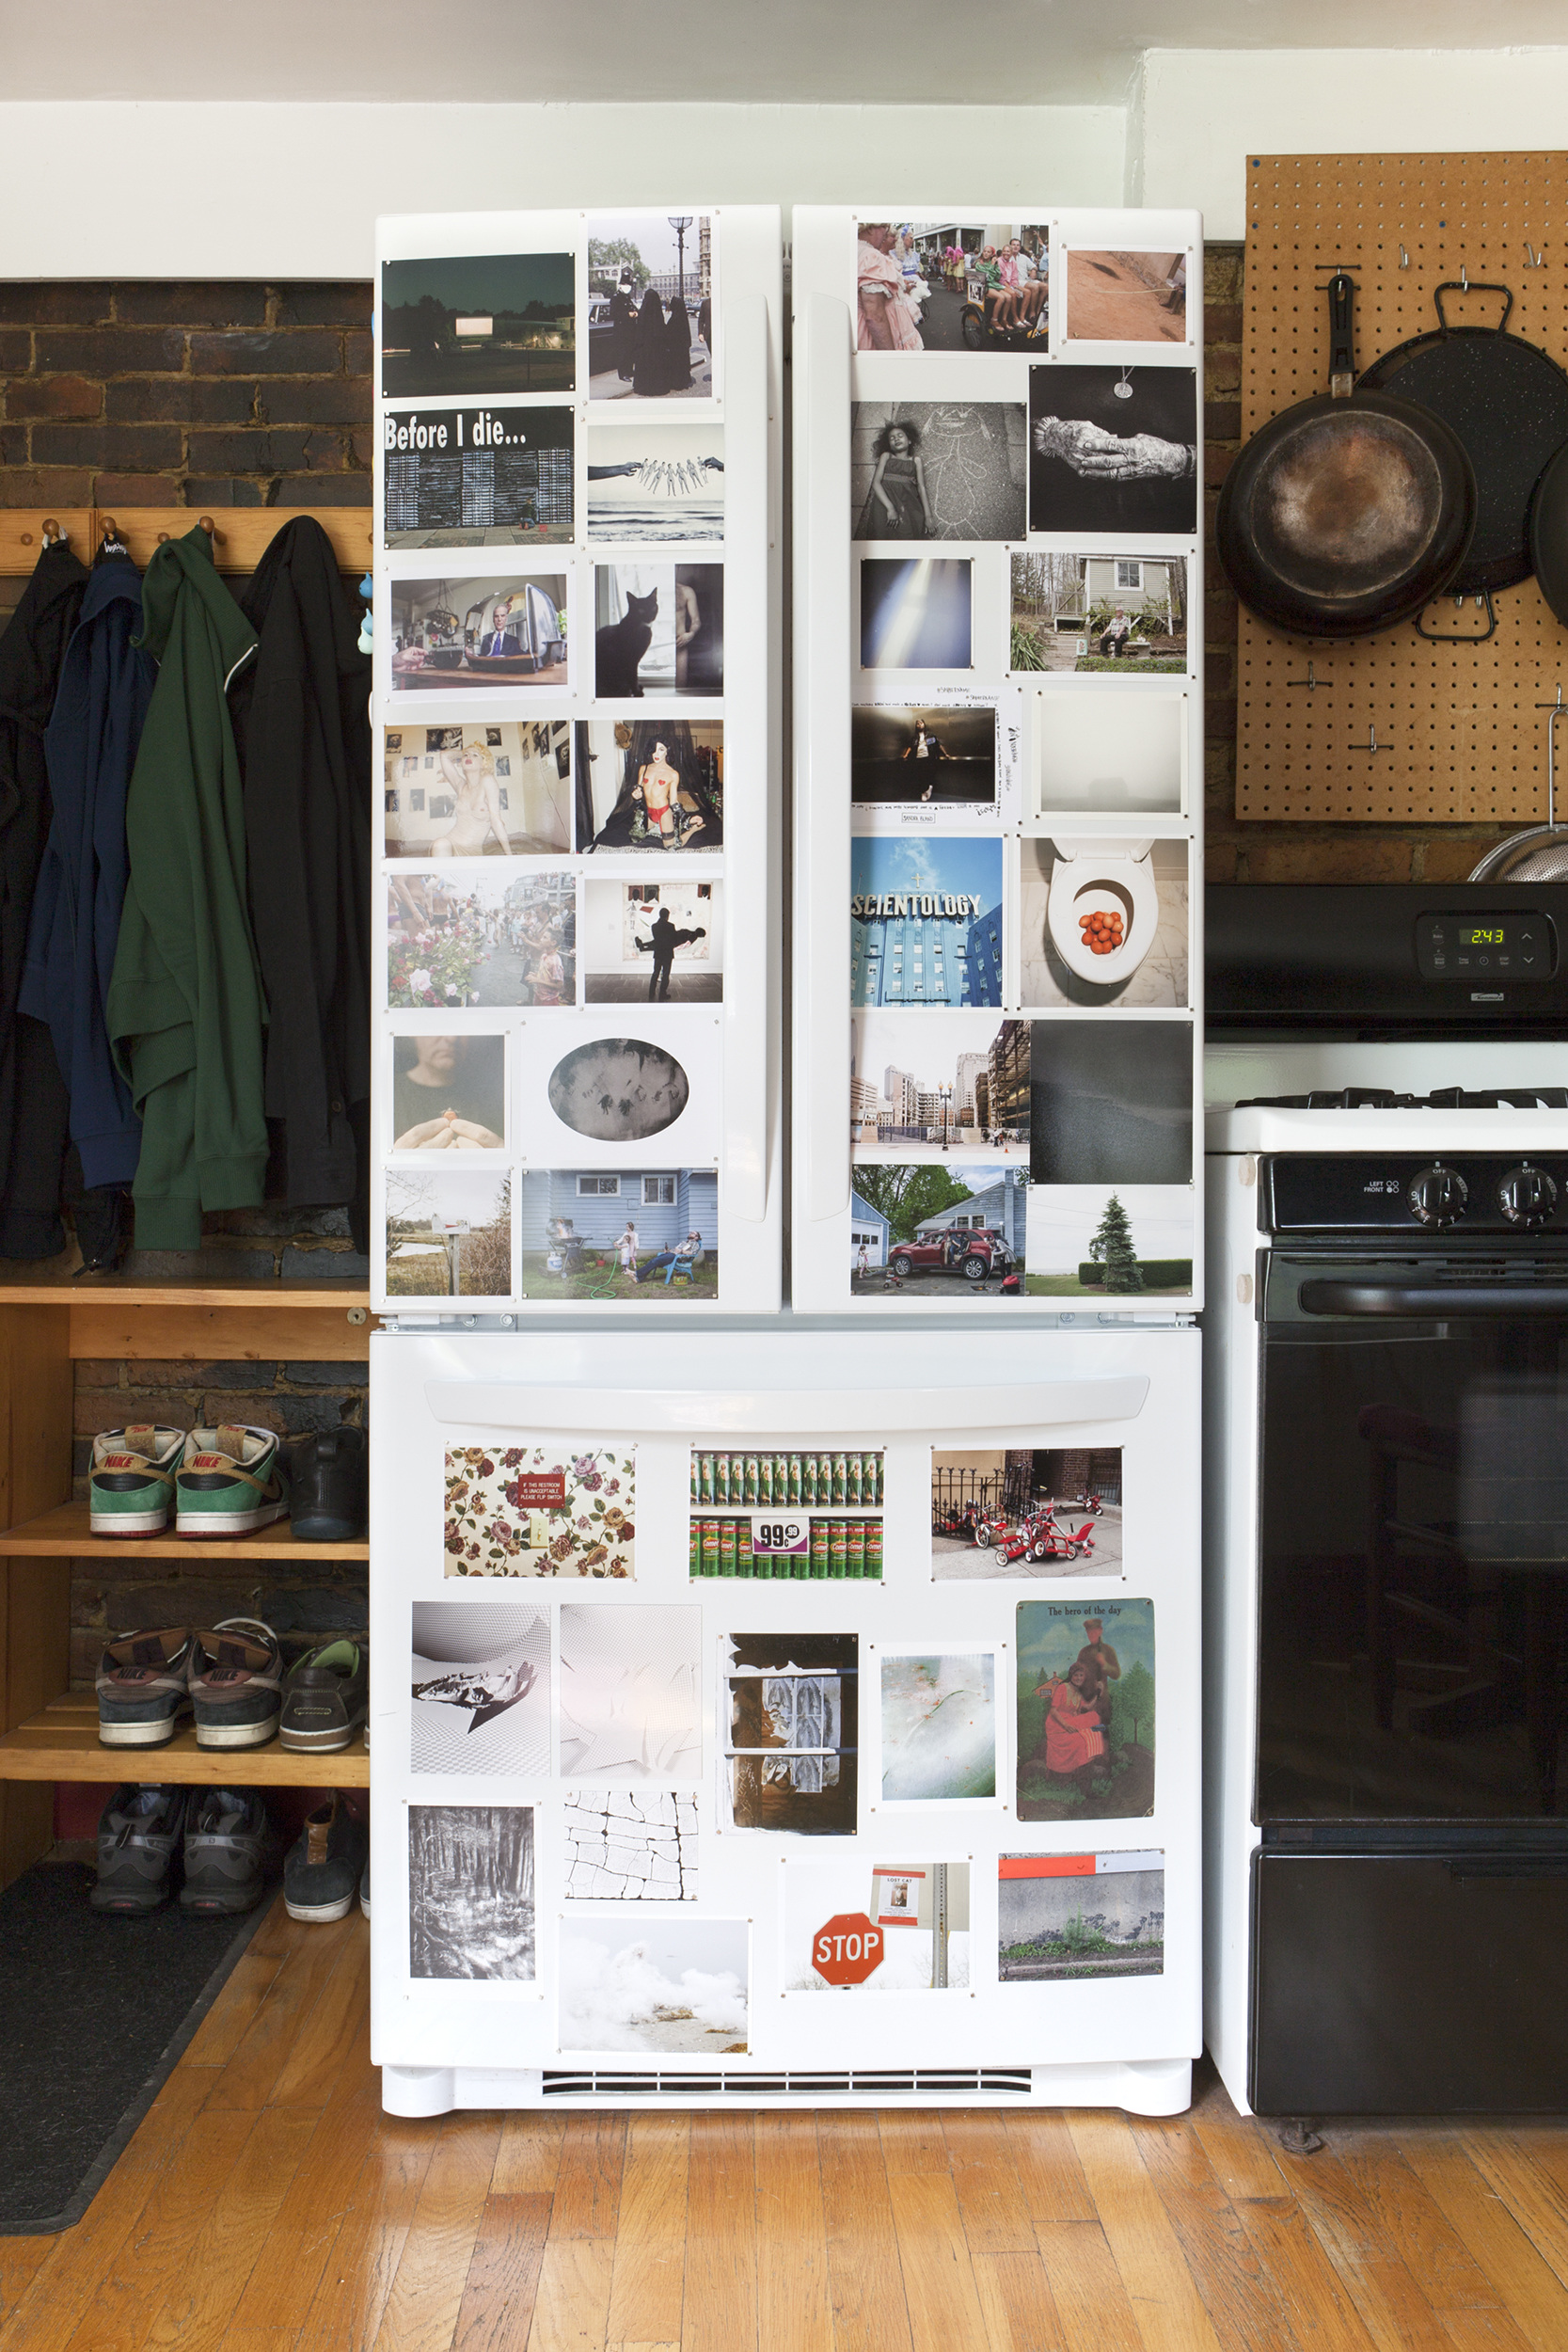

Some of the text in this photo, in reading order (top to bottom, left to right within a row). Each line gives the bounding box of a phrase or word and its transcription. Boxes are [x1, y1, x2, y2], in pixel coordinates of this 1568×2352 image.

[385, 411, 527, 450] Before I die...
[851, 894, 981, 916] SCIENTOLOGY
[1471, 930, 1504, 944] 2:43
[1411, 1191, 1418, 1200] LO
[104, 1454, 135, 1468] NIKE
[192, 1455, 222, 1468] NIKE
[813, 1543, 828, 1551] Comet
[847, 1542, 863, 1550] Comet
[866, 1542, 882, 1550] Comet
[1048, 1605, 1121, 1616] The hero of the day
[117, 1667, 150, 1679] NIKE
[209, 1670, 240, 1681] NIKE
[816, 1932, 879, 1963] STOP
